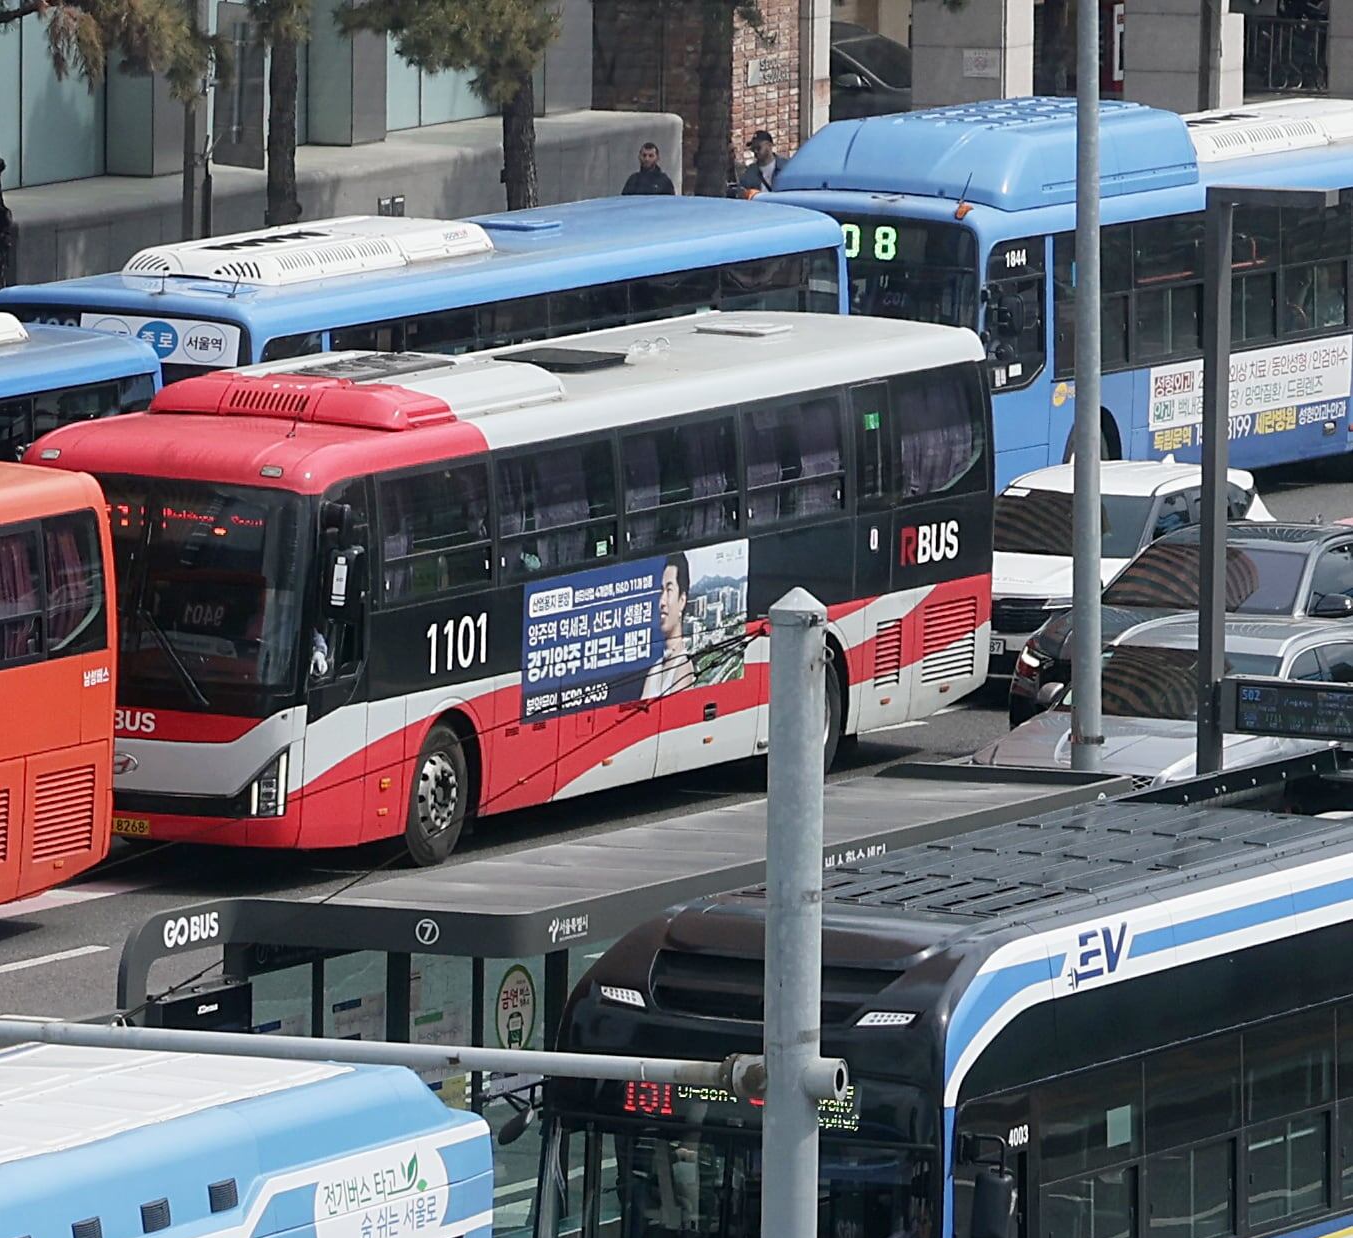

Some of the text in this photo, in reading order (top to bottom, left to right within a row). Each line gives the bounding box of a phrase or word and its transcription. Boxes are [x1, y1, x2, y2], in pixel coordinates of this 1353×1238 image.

[1005, 249, 1027, 267] 1844
[187, 336, 223, 352] 서울역
[900, 519, 959, 567] RBUS
[426, 612, 488, 675] 1101
[528, 622, 558, 647] 양주역
[593, 606, 622, 633] 신도시
[527, 627, 651, 684] 경기양주 테크노밸리
[163, 911, 219, 949] GO BUS
[1008, 1123, 1030, 1148] 4003
[323, 1170, 397, 1216] 전기버스 타고
[403, 1194, 438, 1231] 서울로
